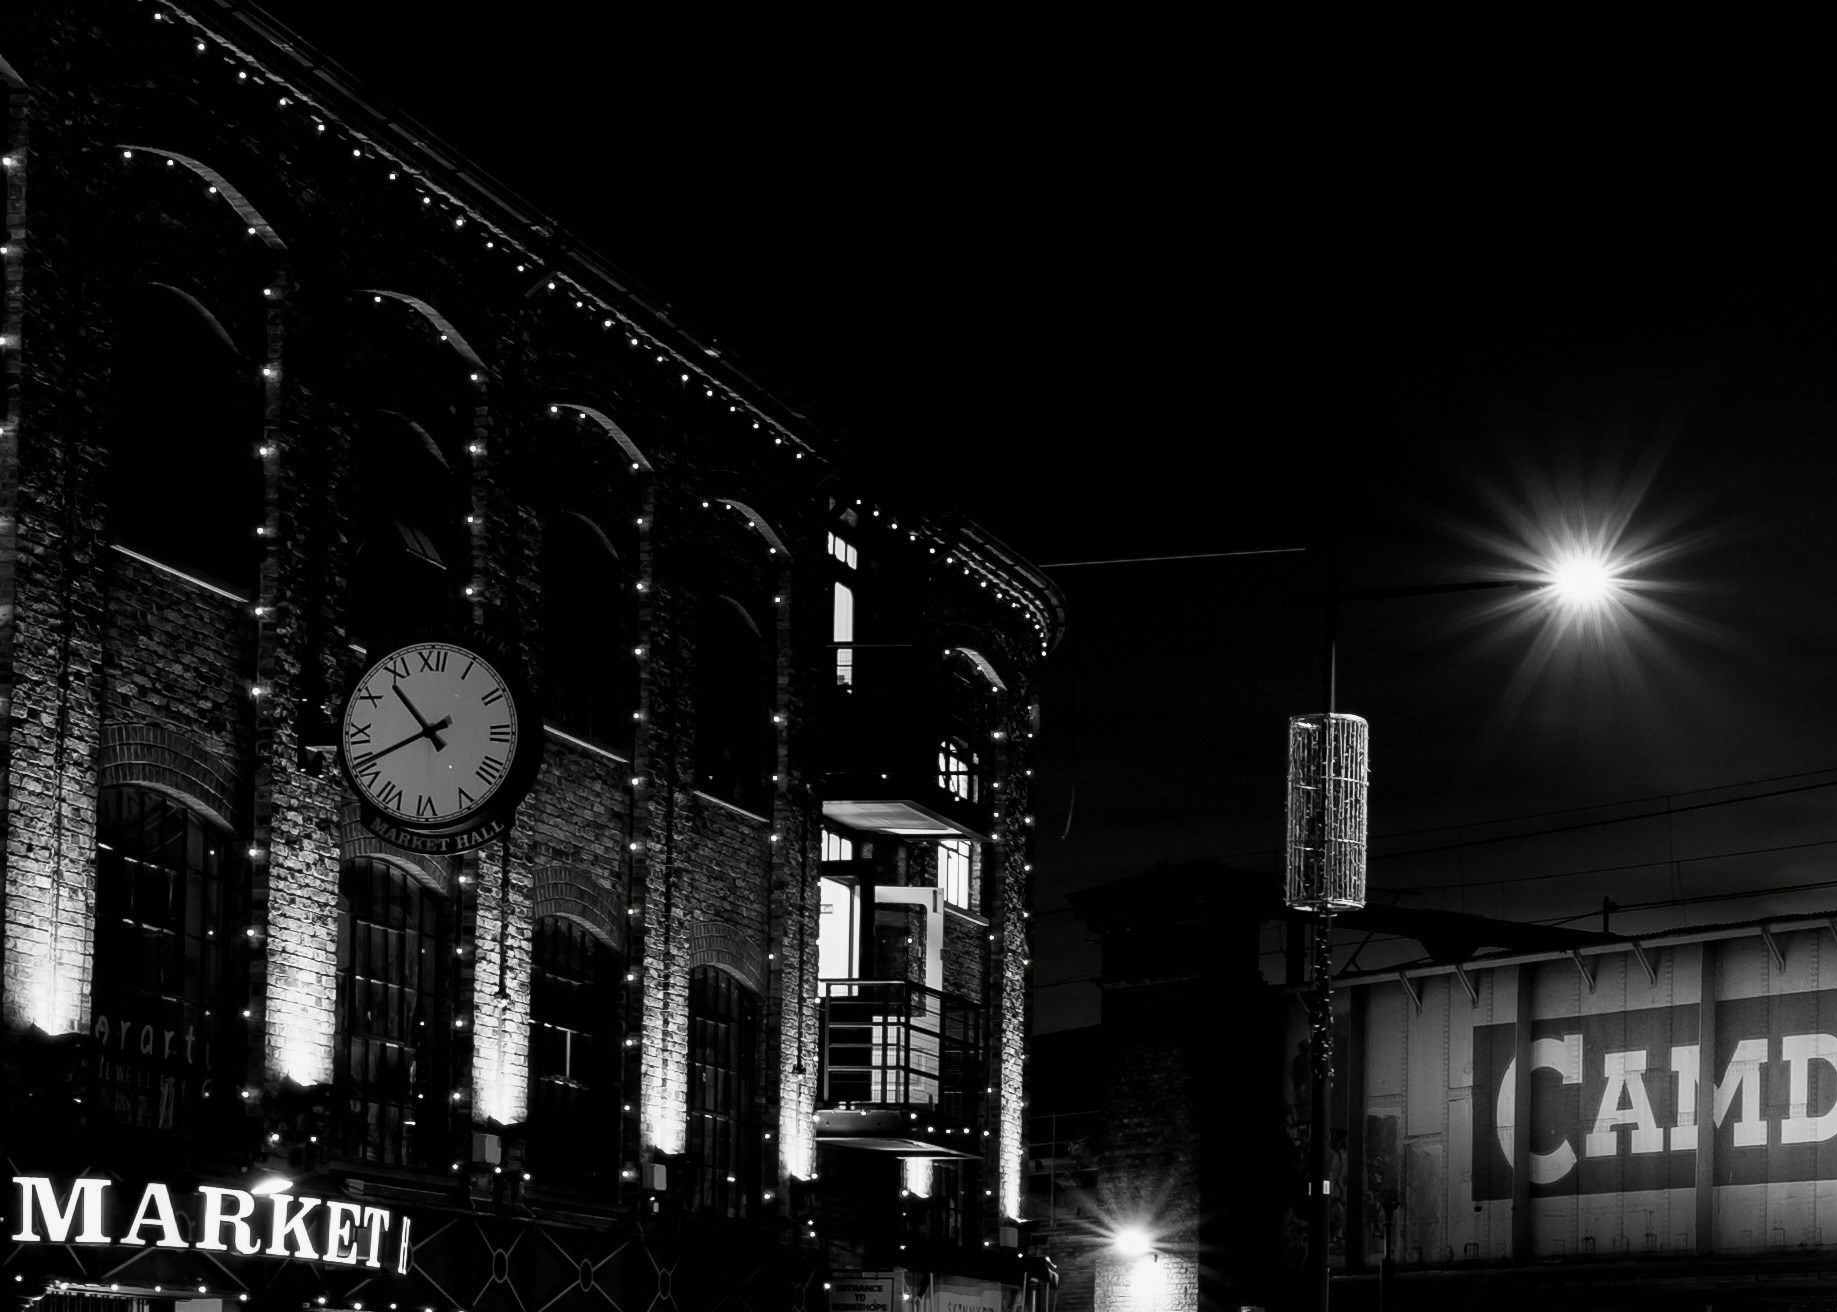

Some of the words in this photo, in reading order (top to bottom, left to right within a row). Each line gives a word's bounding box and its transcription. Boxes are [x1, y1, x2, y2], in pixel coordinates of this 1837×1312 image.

[417, 651, 448, 673] XII
[370, 817, 450, 851] MARKET
[456, 818, 505, 849] HALL
[11, 1176, 390, 1269] MARKET
[835, 1284, 883, 1293] ENTRANCE
[855, 1293, 866, 1303] TO
